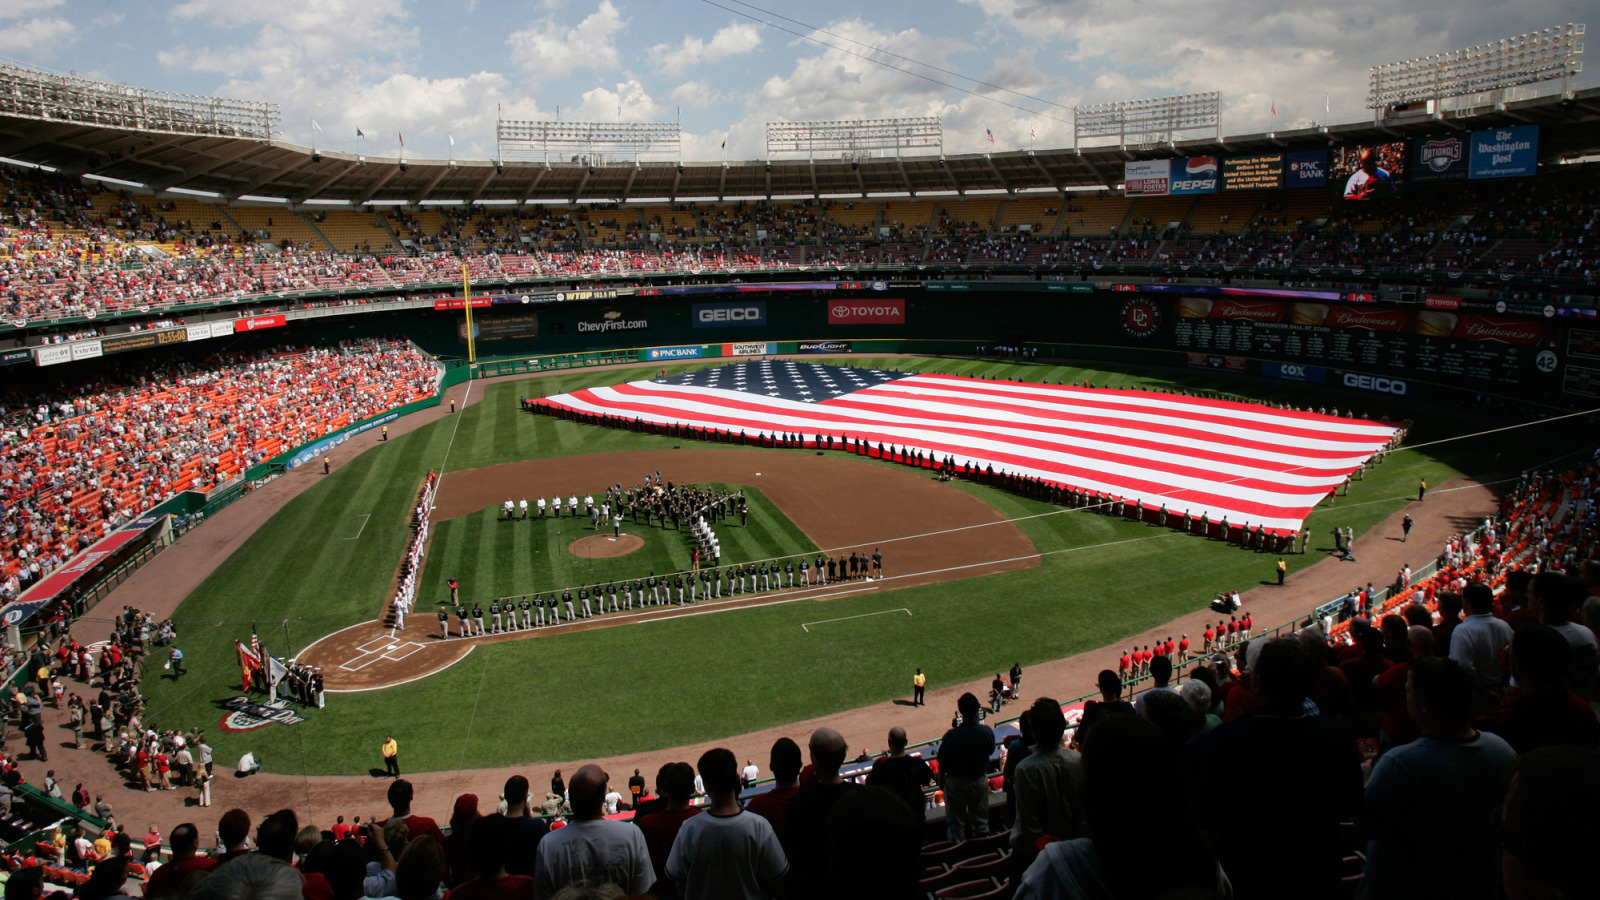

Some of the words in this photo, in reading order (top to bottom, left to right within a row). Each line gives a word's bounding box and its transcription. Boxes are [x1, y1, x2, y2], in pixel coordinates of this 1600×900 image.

[1496, 131, 1512, 141] The
[1423, 145, 1459, 162] NATIONALS
[1479, 141, 1531, 154] Washington
[1300, 162, 1319, 170] PNC
[1492, 154, 1513, 166] Post
[1300, 170, 1325, 179] BANK
[1172, 180, 1217, 191] PEPSI
[566, 292, 592, 300] WTOP
[699, 308, 760, 322] GEICO
[851, 307, 900, 316] TOYOTA
[1221, 305, 1278, 318] Budweiser
[1336, 312, 1397, 326] Budweiser
[577, 320, 647, 332] ChevyFirst.com
[1465, 322, 1536, 339] Budweiser
[158, 330, 186, 344] 12:55:08
[1538, 356, 1554, 369] 42
[1281, 364, 1305, 378] COX
[1343, 373, 1406, 395] GEICO
